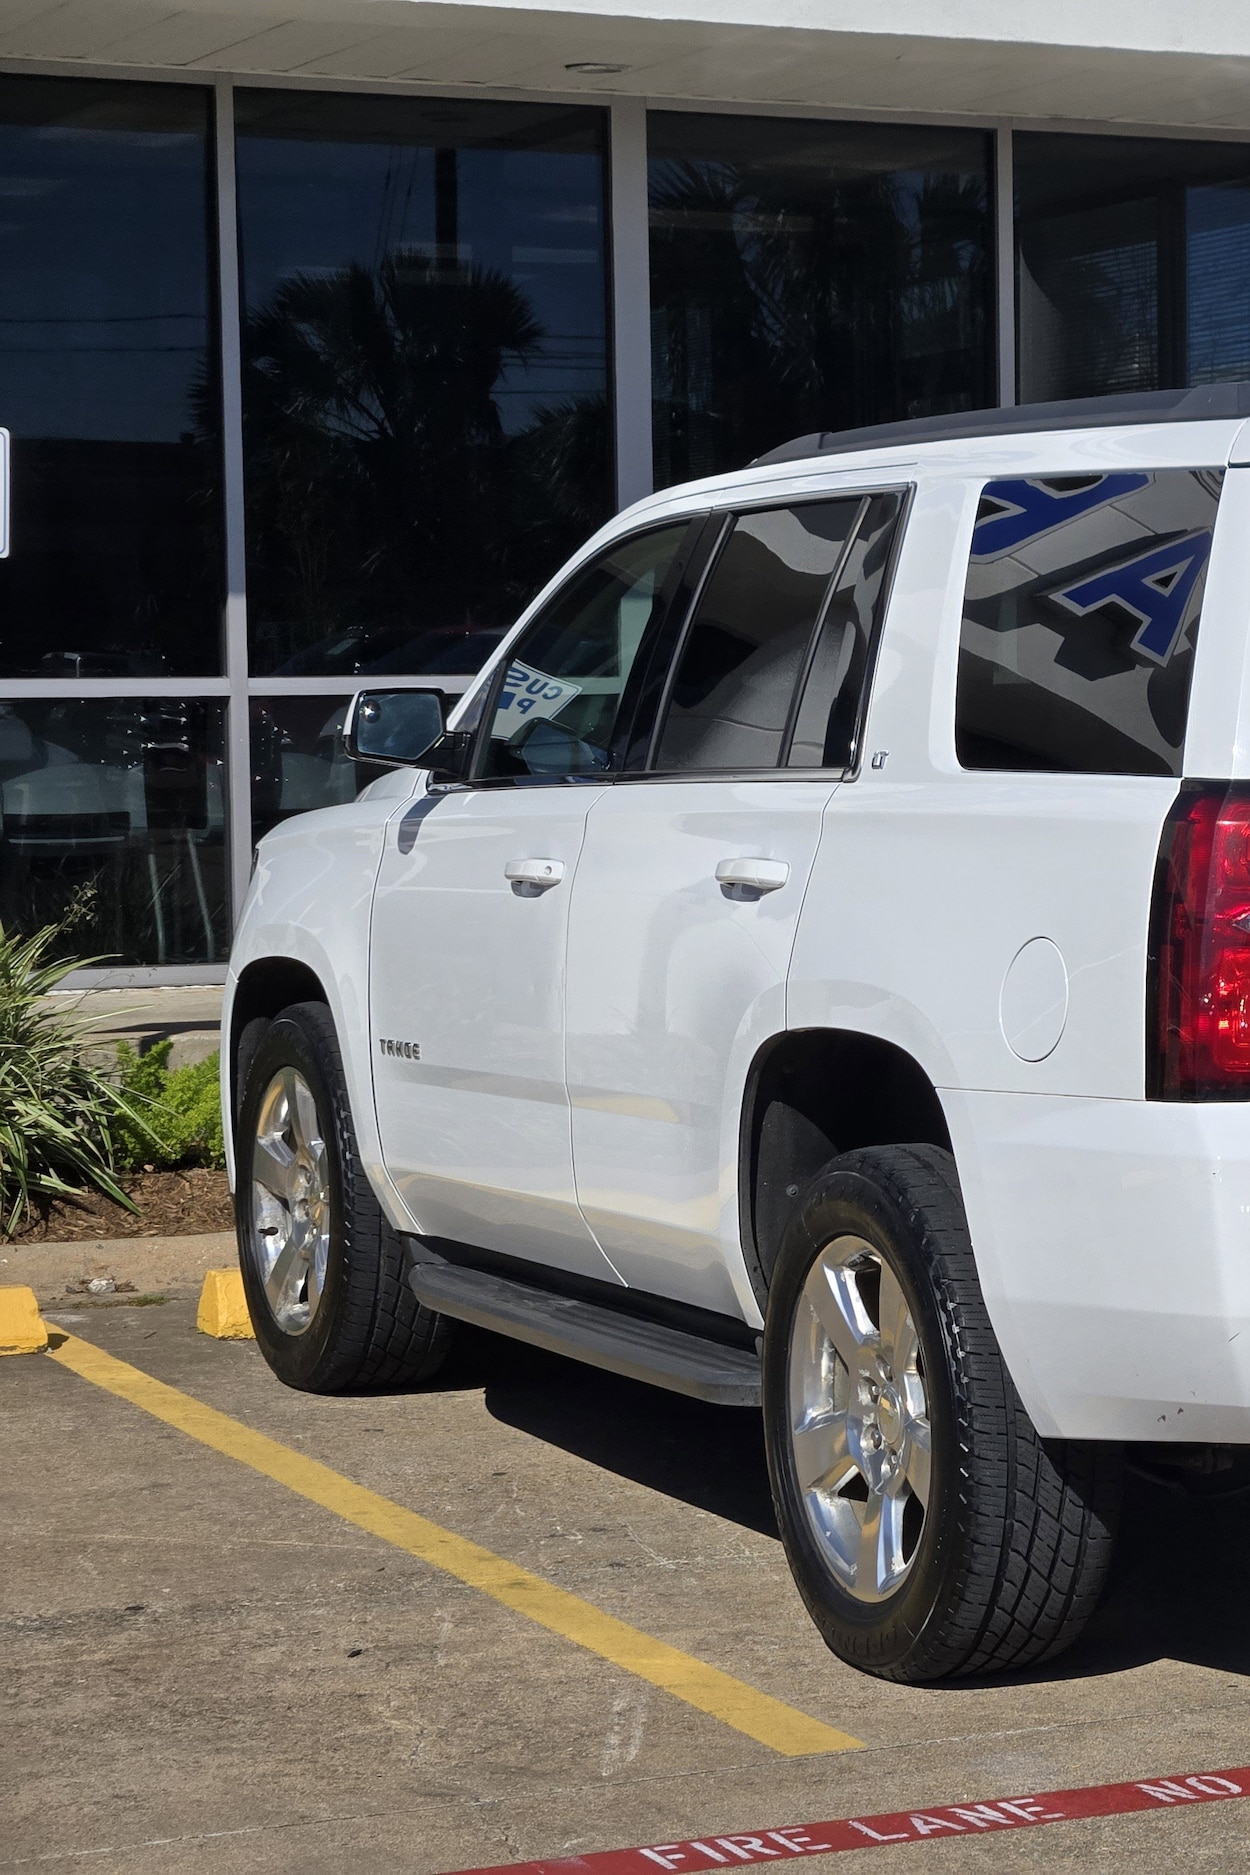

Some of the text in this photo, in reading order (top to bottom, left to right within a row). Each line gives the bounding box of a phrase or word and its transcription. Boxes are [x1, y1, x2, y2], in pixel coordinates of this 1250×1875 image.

[379, 1038, 421, 1061] TAHOE
[639, 1828, 832, 1870] FIRE
[848, 1798, 1066, 1842] LANE
[1134, 1774, 1243, 1803] NO
